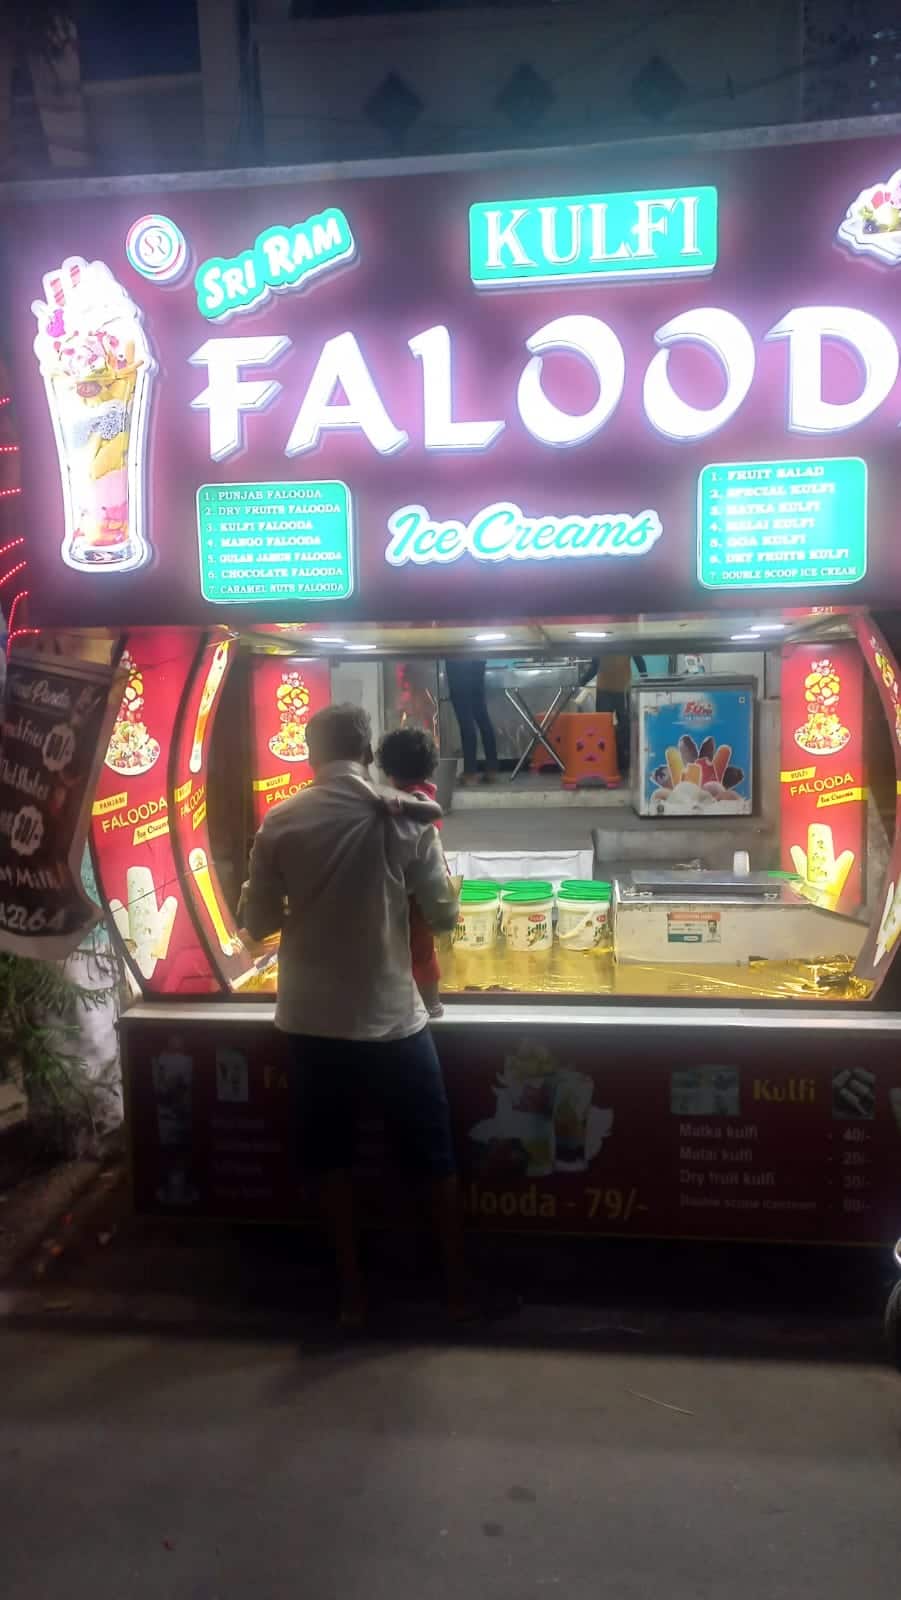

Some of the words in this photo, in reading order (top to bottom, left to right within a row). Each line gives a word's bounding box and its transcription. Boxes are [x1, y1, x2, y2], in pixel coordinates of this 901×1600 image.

[482, 196, 703, 269] KULFI
[203, 259, 256, 309] SRI
[263, 217, 342, 277] RAM
[188, 305, 901, 462] FALOOD
[727, 469, 772, 481] FRUIT
[776, 466, 824, 479] SALAD
[218, 491, 263, 501] PUNJAB
[267, 489, 321, 500] FALOODA
[218, 506, 241, 516] DRY
[245, 505, 285, 515] FRUITS
[288, 503, 341, 514] FALOODA
[258, 520, 313, 531] FALOODA
[392, 511, 462, 558] Ice
[472, 509, 655, 555] Creams
[267, 535, 321, 546] FALOODA
[294, 551, 342, 561] FALOODA
[221, 568, 289, 579] CHOCOLATE
[291, 567, 343, 577] FALOODA
[722, 569, 761, 579] DOUBLE
[765, 568, 797, 578] SCOOP
[800, 567, 818, 577] ICE
[820, 566, 857, 576] CREAM
[220, 584, 267, 594] CARAMEL
[270, 583, 295, 593] NUTS
[298, 582, 344, 593] FALOODA
[265, 779, 313, 804] FALOO
[790, 771, 854, 797] FALOODA
[101, 795, 168, 833] FALOODA
[752, 1077, 817, 1104] Kulfi
[463, 1184, 556, 1217] looda
[584, 1184, 649, 1222] 79/-
